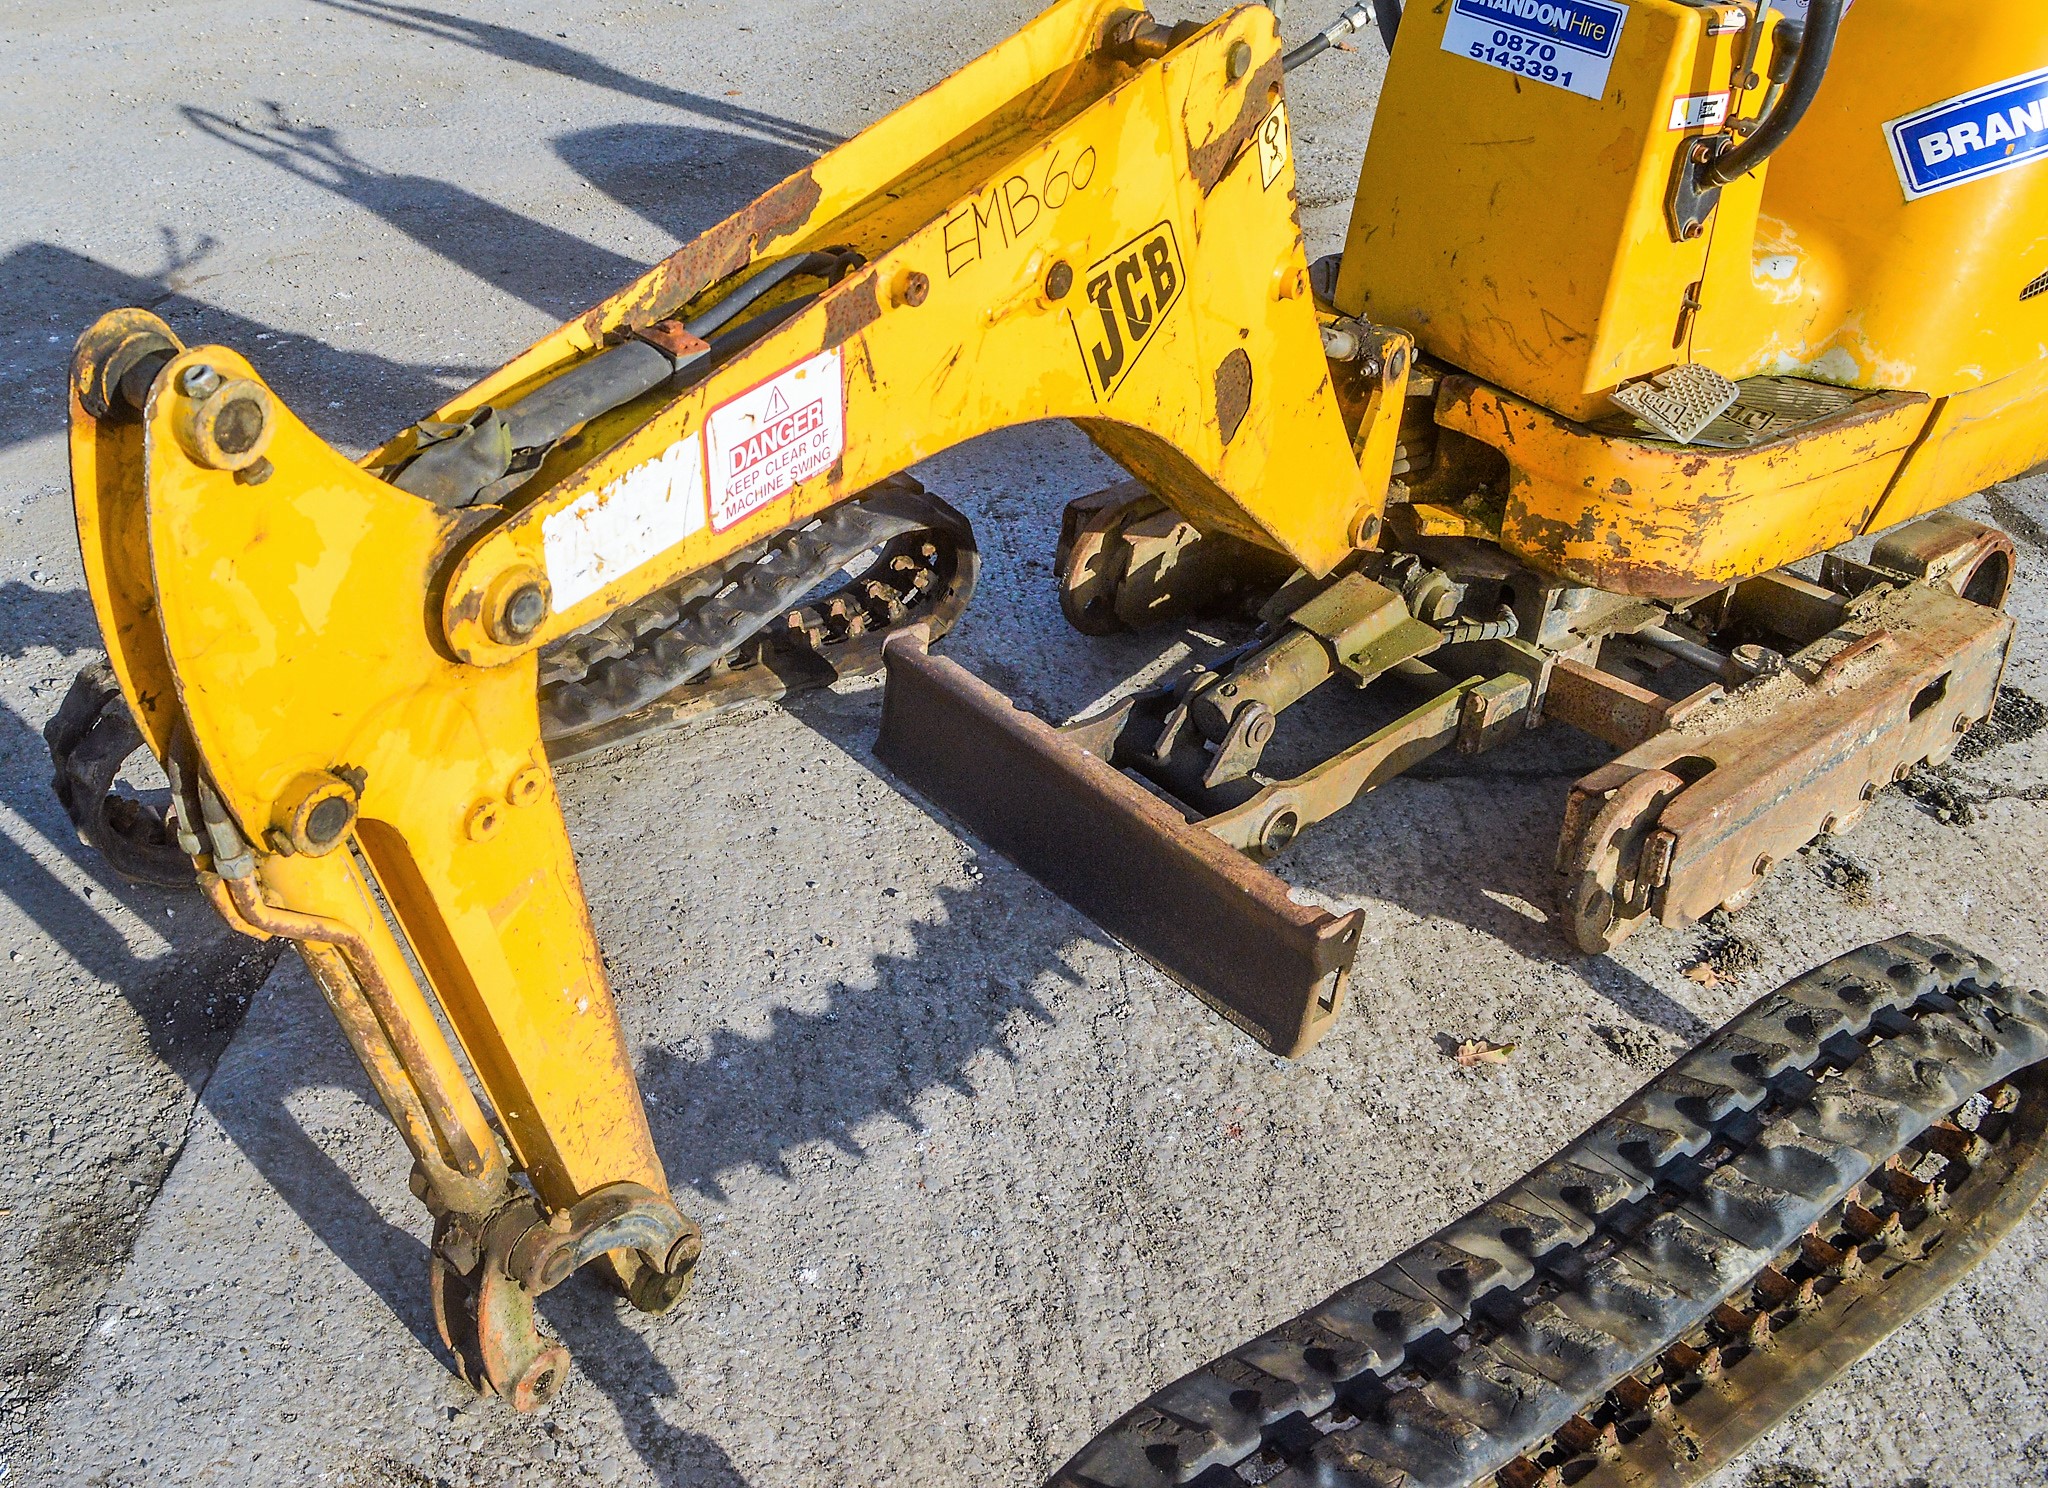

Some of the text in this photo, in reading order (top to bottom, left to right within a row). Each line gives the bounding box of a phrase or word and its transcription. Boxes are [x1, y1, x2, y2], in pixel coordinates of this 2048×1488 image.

[1469, 41, 1573, 88] 5143391
[1492, 30, 1556, 62] 0870
[1918, 97, 2048, 167] BRAN
[943, 145, 1096, 278] EMB60
[1086, 235, 1176, 392] JCB
[725, 470, 760, 497] KEEP
[764, 442, 807, 476] CLEAR
[812, 428, 829, 448] OF
[731, 400, 823, 474] DANGER
[725, 446, 831, 519] MACHINE SWING
